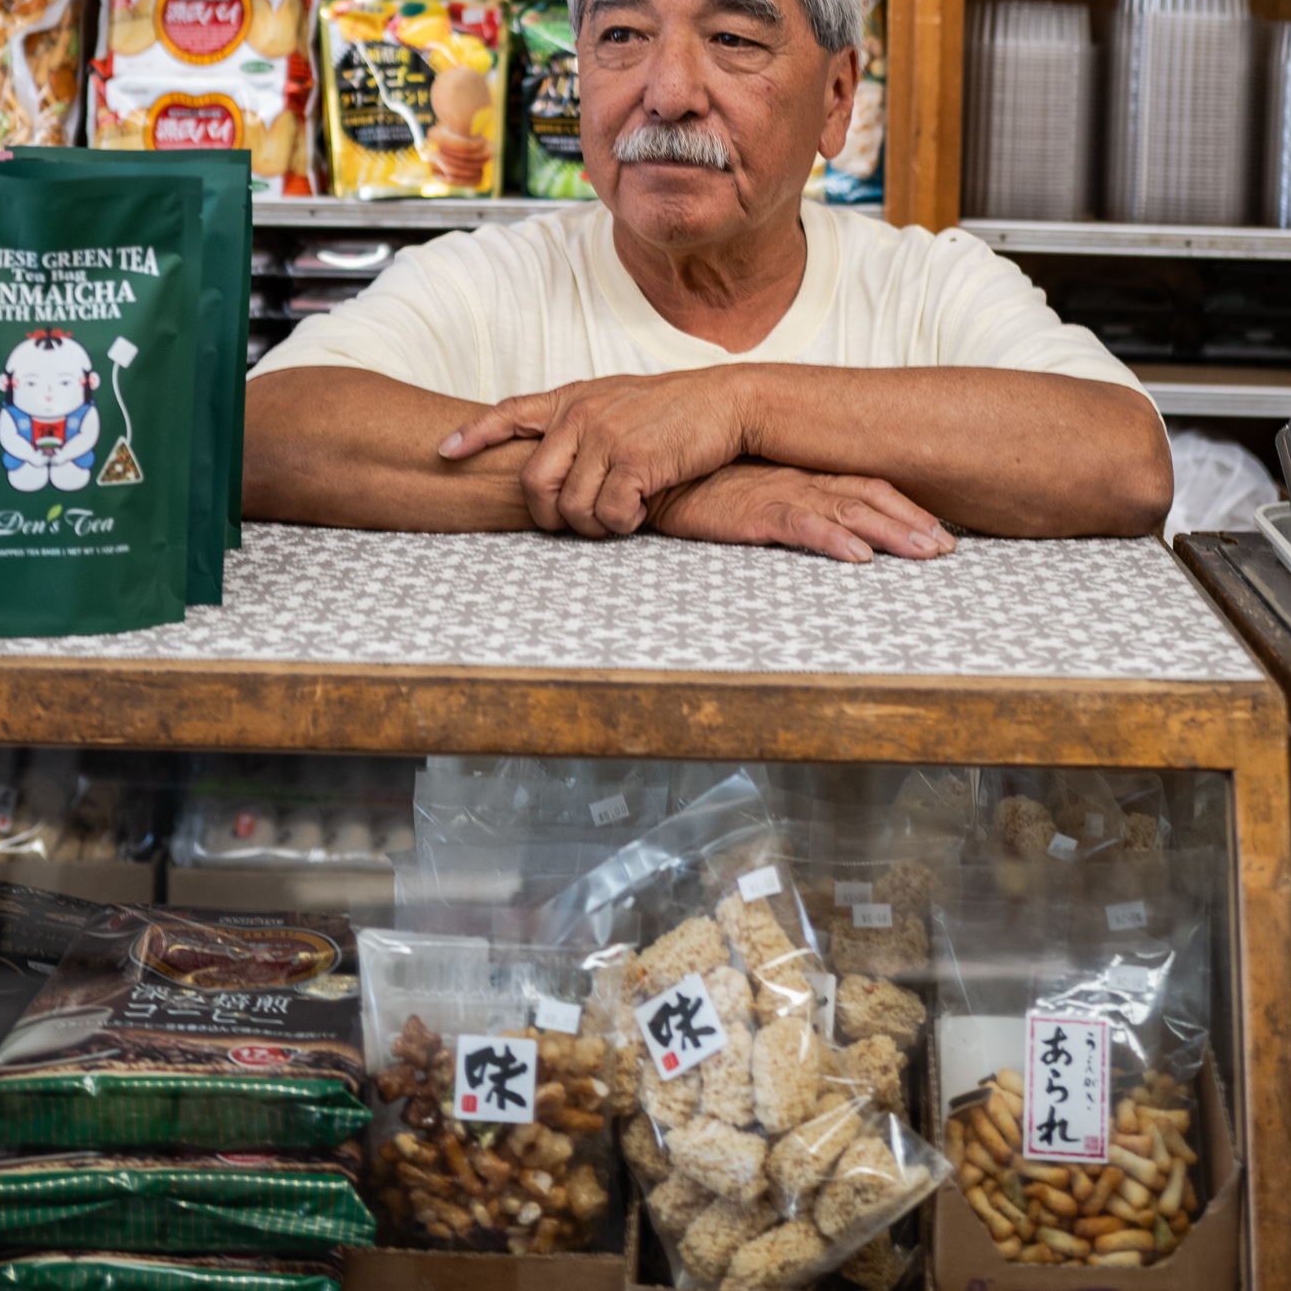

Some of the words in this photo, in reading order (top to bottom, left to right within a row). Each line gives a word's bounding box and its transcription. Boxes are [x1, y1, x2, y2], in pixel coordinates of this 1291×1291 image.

[11, 267, 45, 283] Tea
[50, 268, 87, 284] Bag
[41, 248, 113, 270] GREEN
[116, 246, 160, 277] TEA
[34, 302, 121, 322] MATCHA
[64, 508, 114, 537] Tea
[647, 991, 717, 1051] 味
[464, 1043, 528, 1110] 味
[1036, 1026, 1080, 1146] あられ
